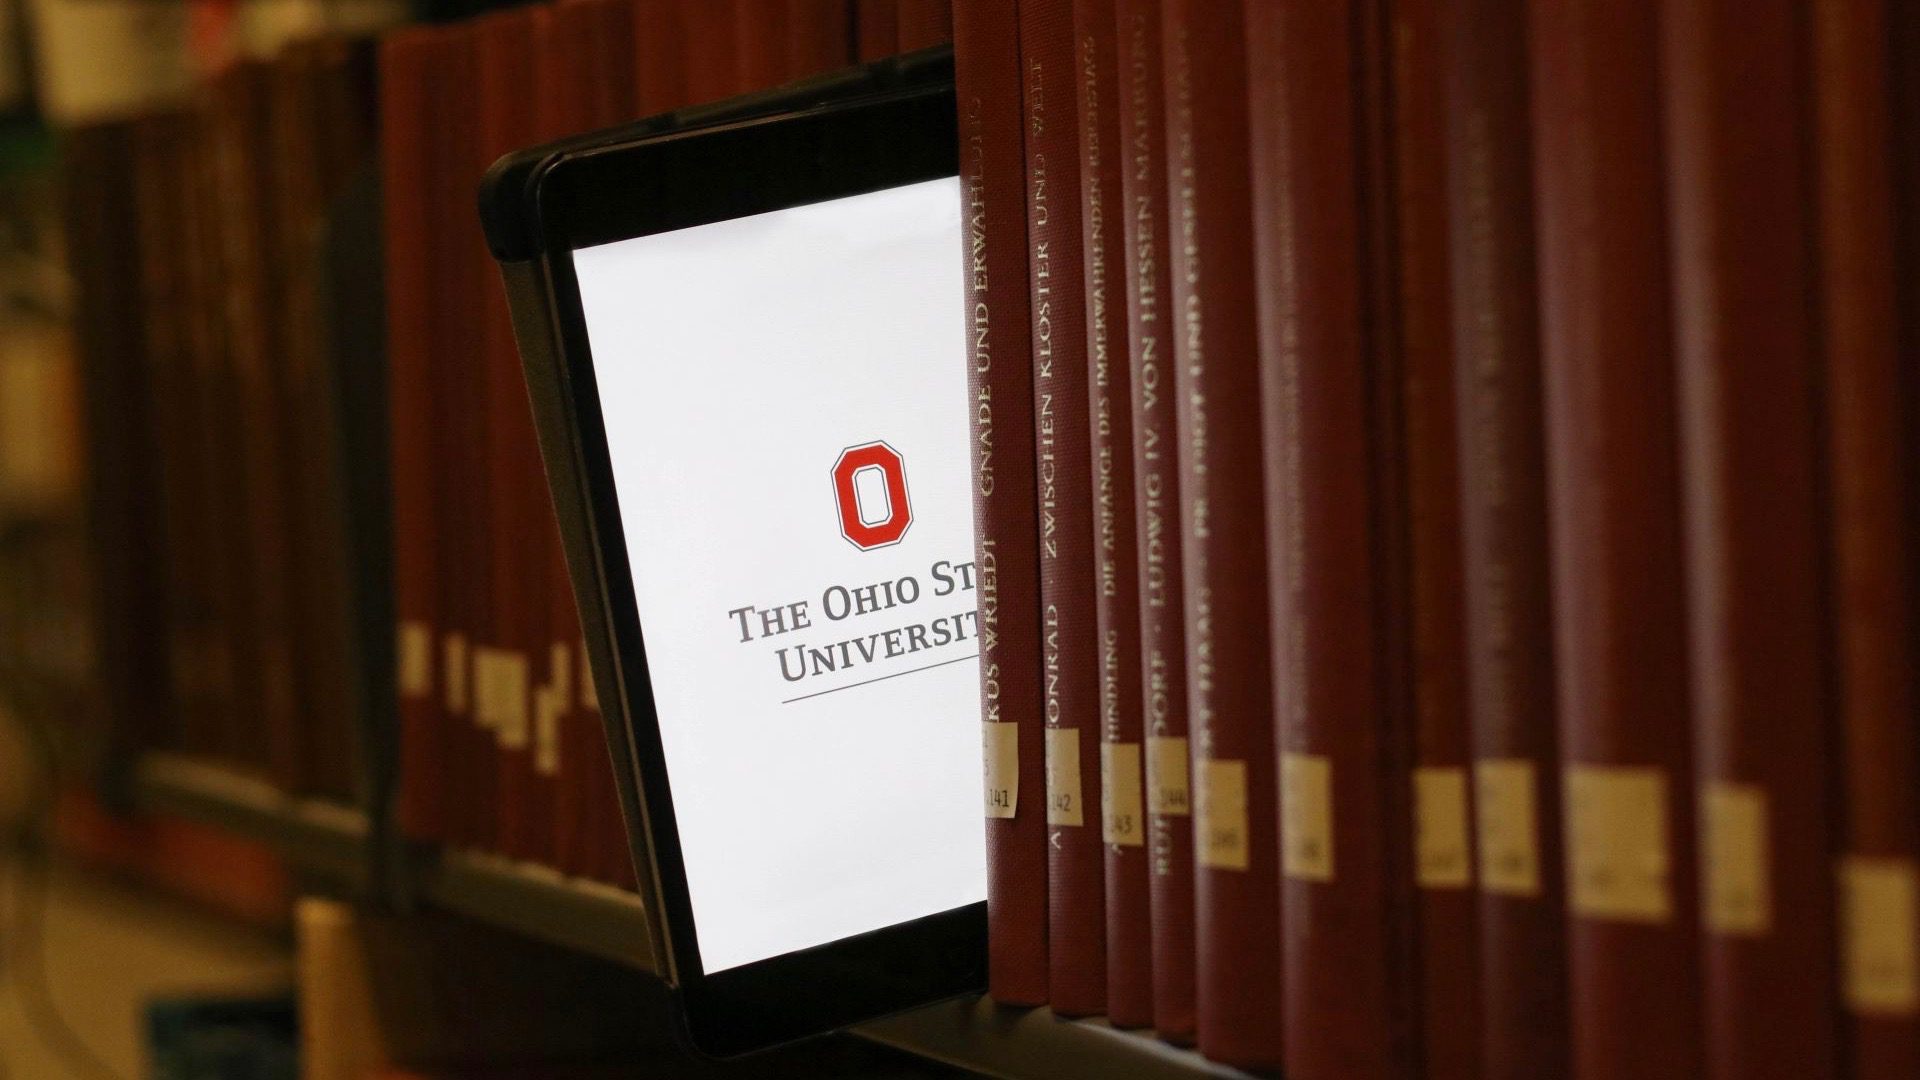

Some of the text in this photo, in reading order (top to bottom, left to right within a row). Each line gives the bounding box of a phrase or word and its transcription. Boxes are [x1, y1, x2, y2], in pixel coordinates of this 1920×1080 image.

[1037, 241, 1052, 377] KLOSTER
[1137, 195, 1157, 322] HESSEN
[974, 302, 991, 372] UND
[1141, 334, 1158, 409] VON
[977, 384, 995, 497] GNADE
[1096, 396, 1111, 435] DES
[831, 440, 914, 552] O
[1040, 393, 1057, 558] ZWISCHEN
[982, 534, 1000, 652] WRIEDT
[1101, 559, 1116, 595] DIE
[1144, 472, 1165, 607] LUDWIG
[728, 601, 812, 644] THE
[822, 576, 920, 621] OHIO
[1047, 604, 1060, 729] ONRAD
